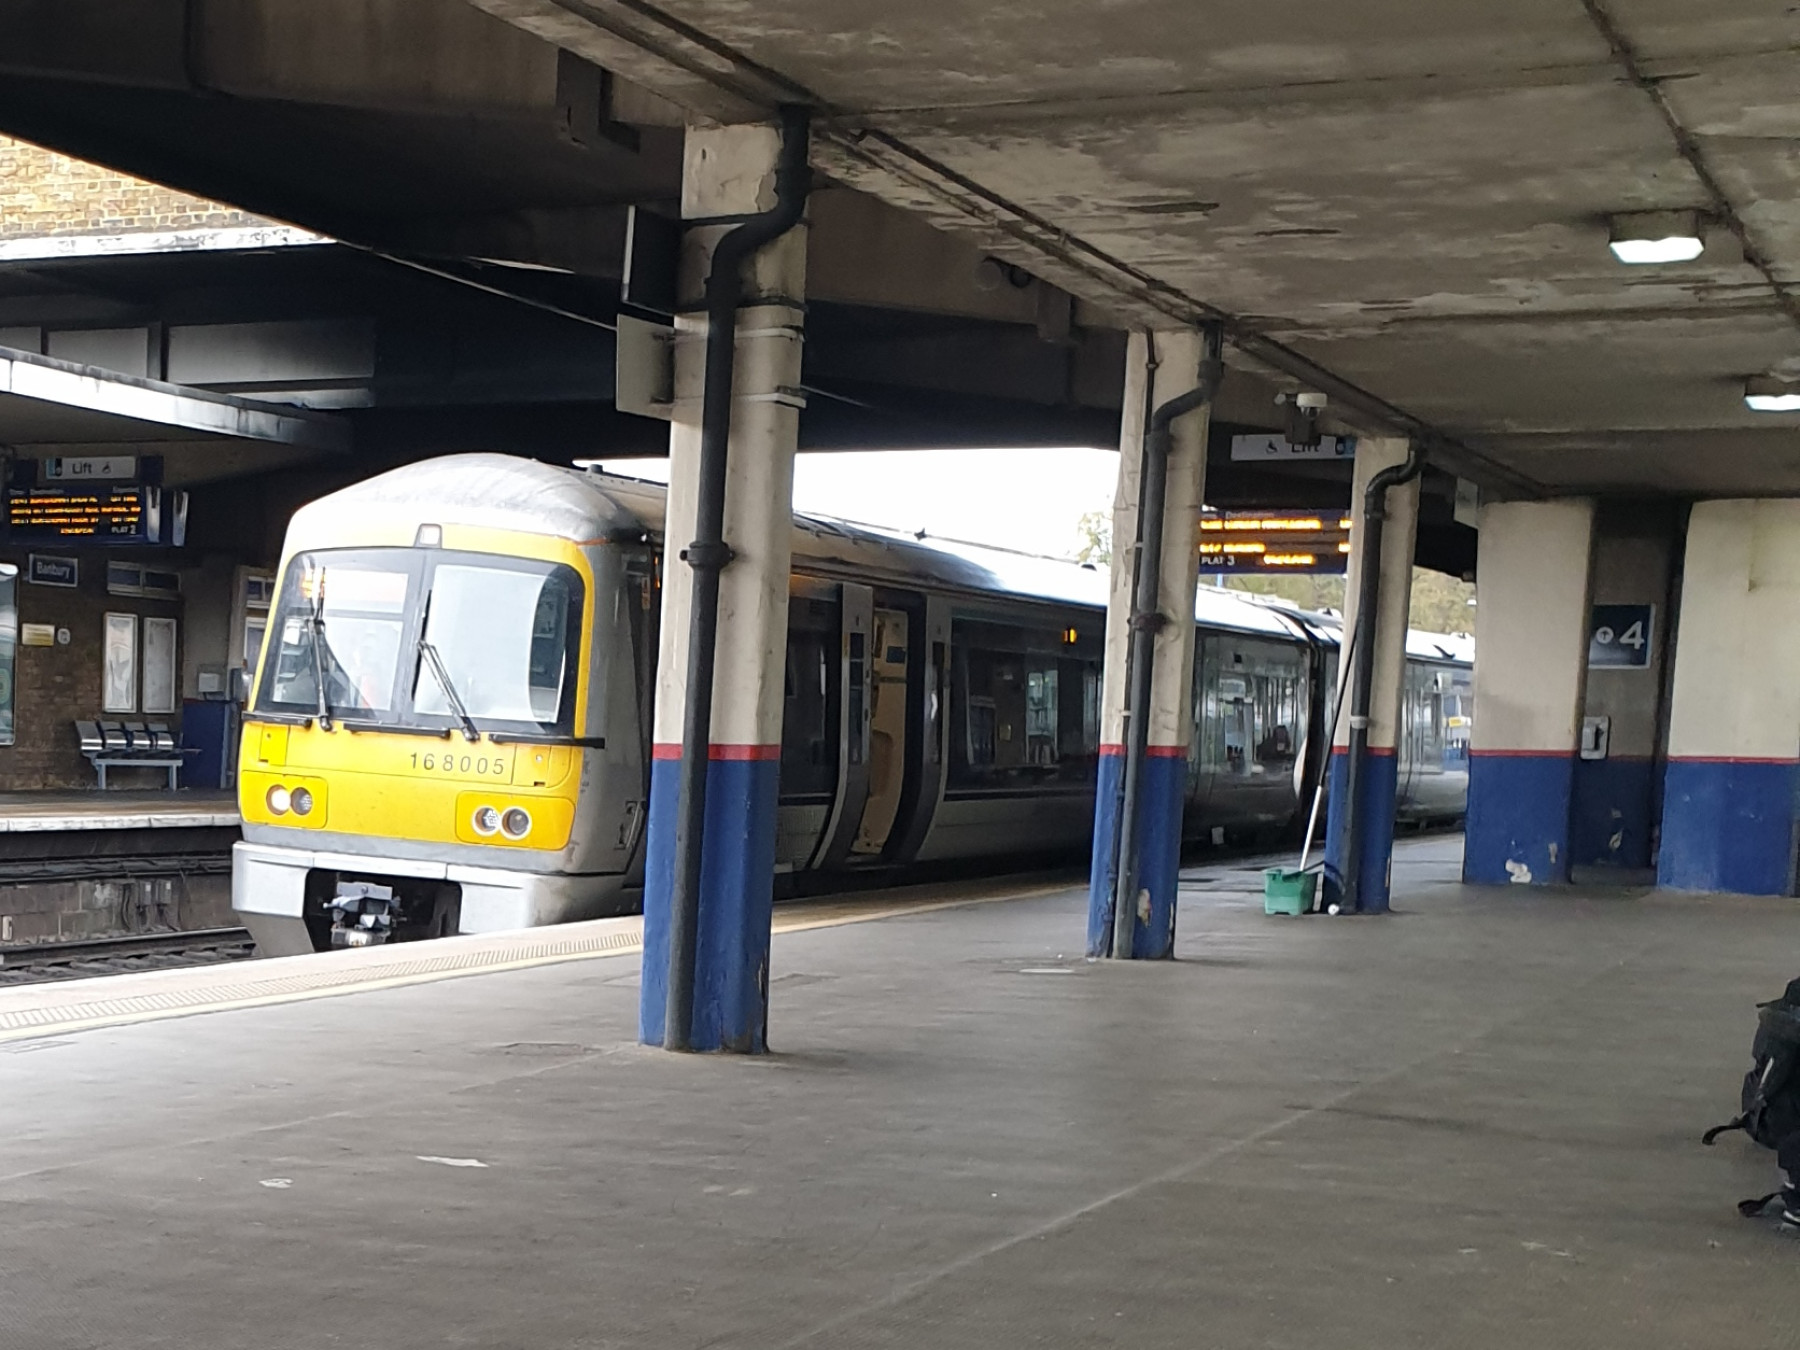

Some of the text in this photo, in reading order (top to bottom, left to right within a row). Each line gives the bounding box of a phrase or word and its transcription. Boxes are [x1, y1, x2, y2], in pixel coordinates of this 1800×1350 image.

[72, 462, 92, 474] Lift
[130, 524, 136, 534] 2
[1201, 555, 1235, 566] PLAT 3
[36, 561, 70, 580] Banbury
[1619, 620, 1645, 650] 4
[410, 752, 504, 775] 168005
